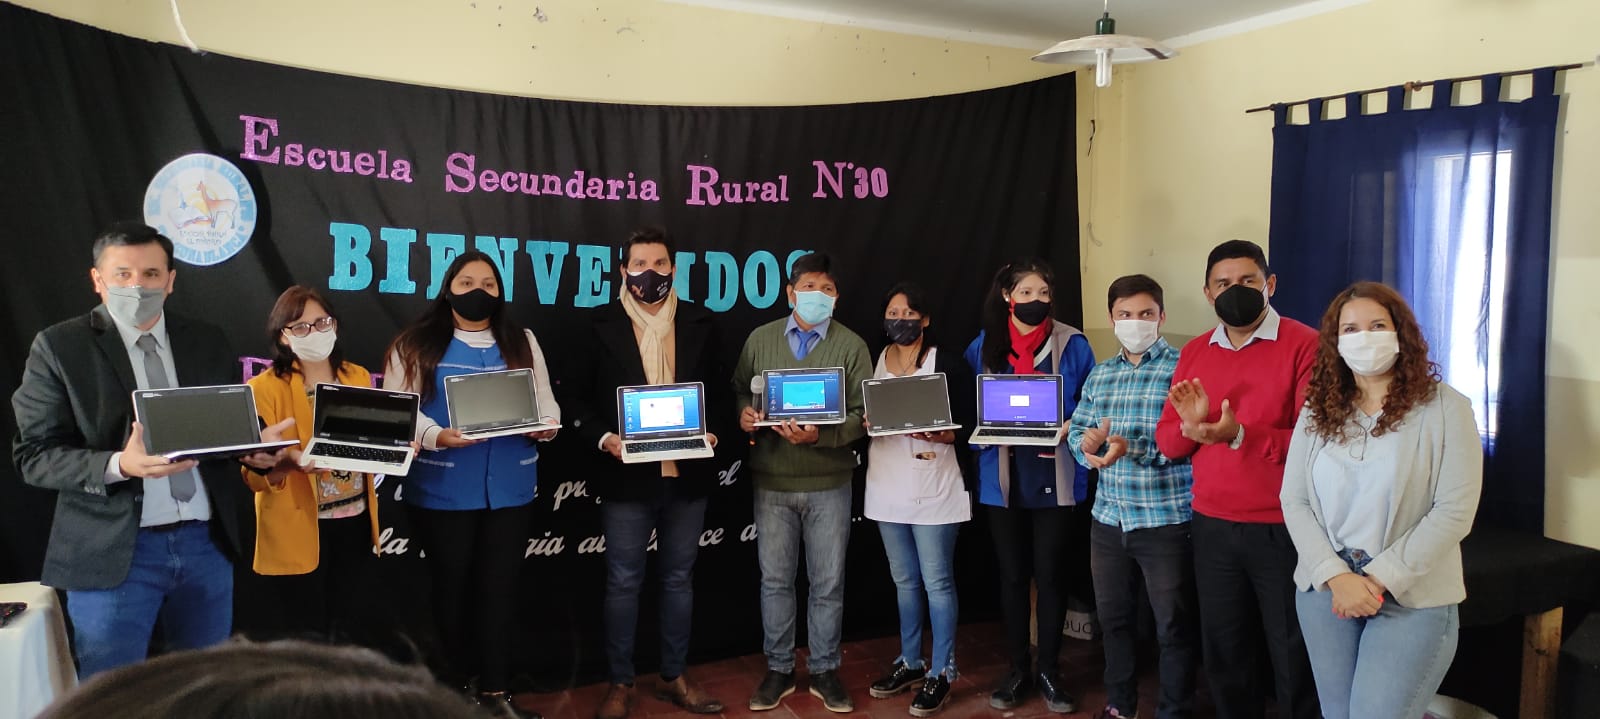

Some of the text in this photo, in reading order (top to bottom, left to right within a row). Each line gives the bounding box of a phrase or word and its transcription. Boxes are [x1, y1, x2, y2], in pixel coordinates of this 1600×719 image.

[239, 114, 413, 184] Escuela
[445, 152, 660, 202] Secundaria
[686, 164, 789, 207] Rural
[328, 222, 817, 313] BIENVEIDO
